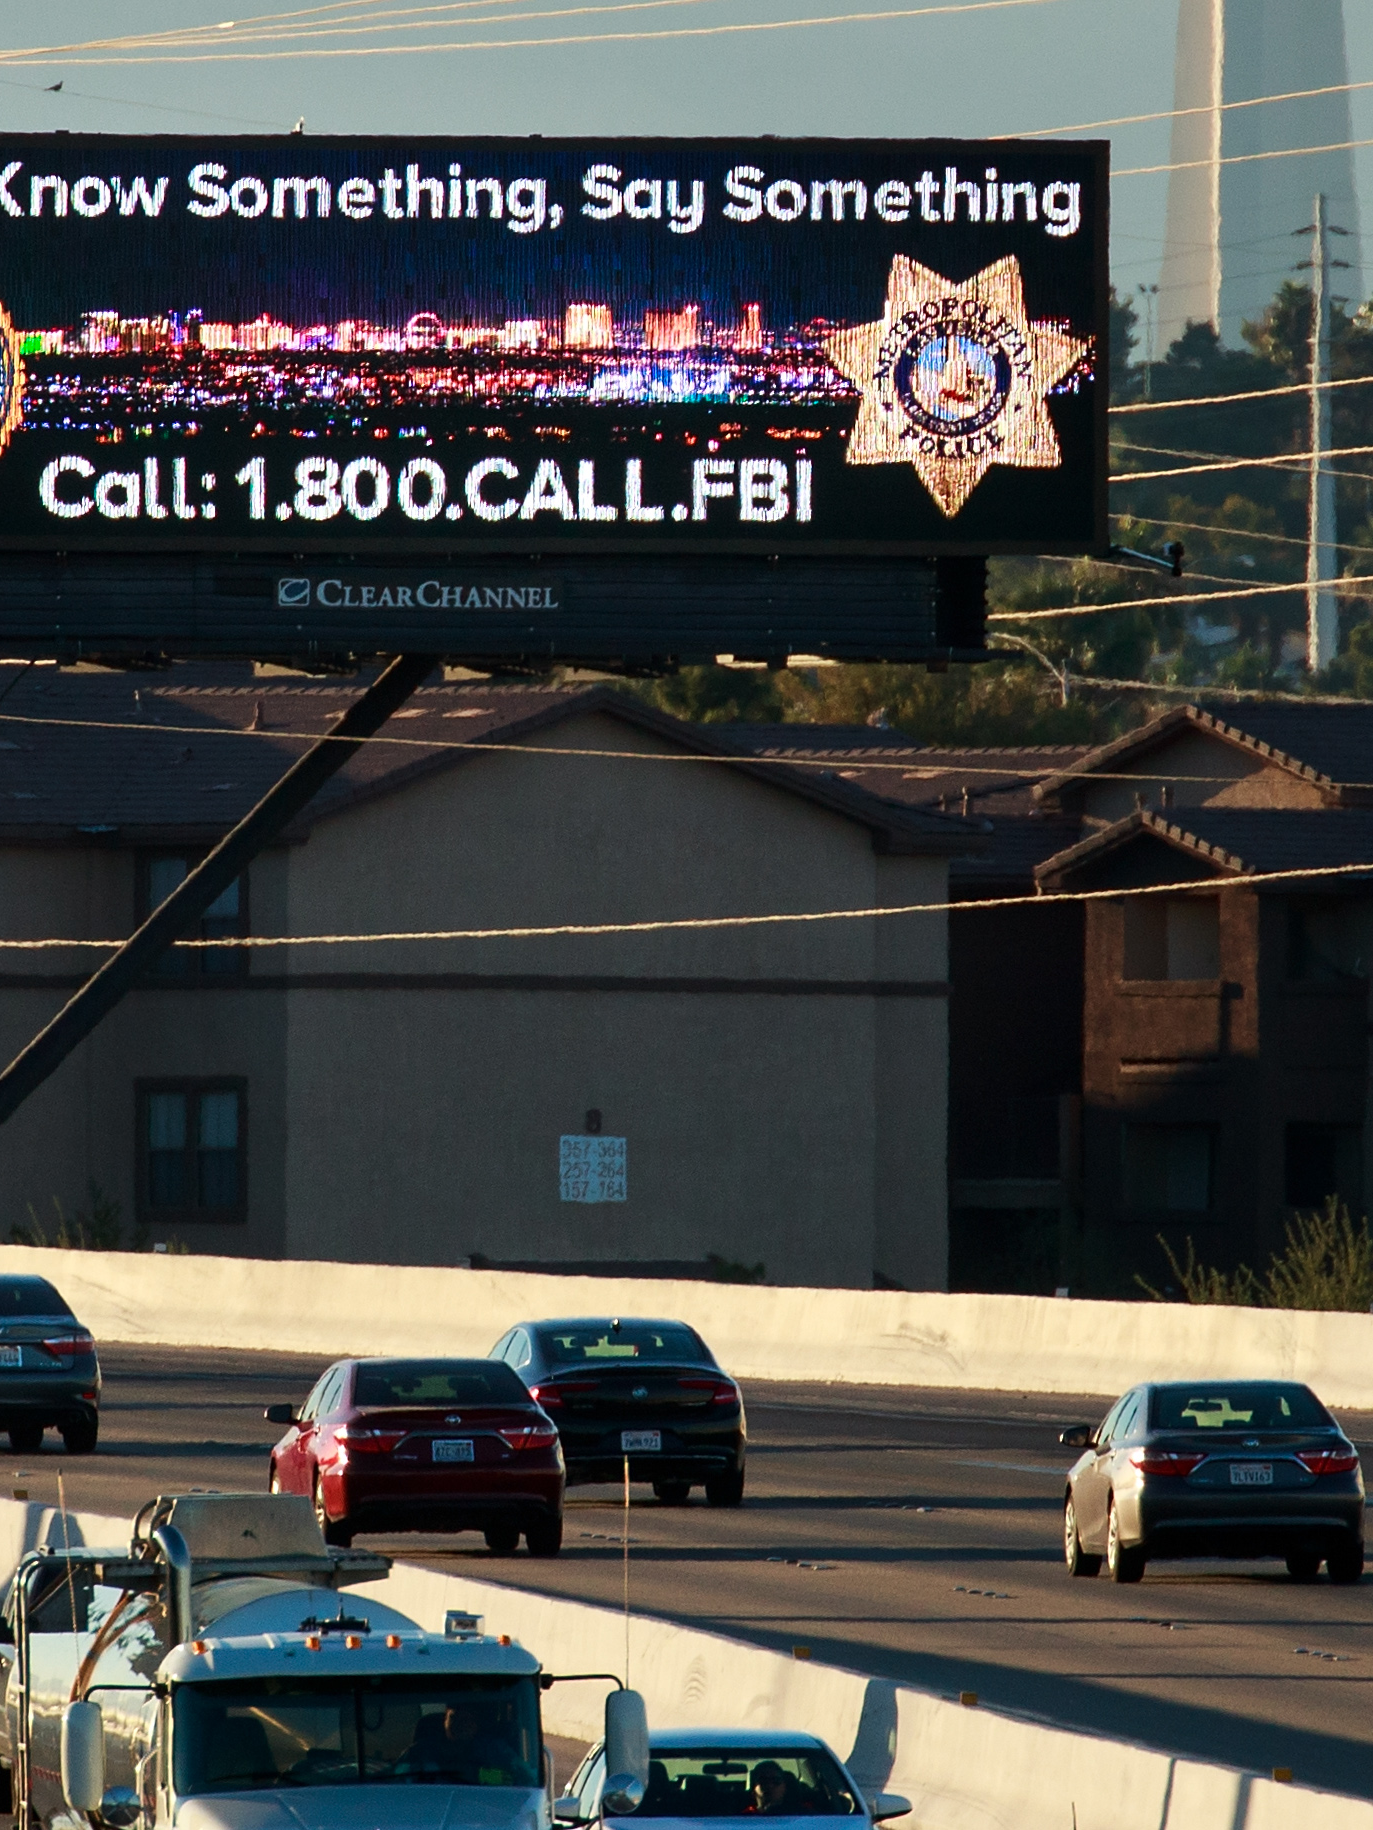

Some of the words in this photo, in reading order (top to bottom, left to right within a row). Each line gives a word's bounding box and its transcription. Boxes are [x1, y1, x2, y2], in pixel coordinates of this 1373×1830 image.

[186, 162, 564, 233] Something,
[582, 164, 705, 233] Say
[722, 165, 1081, 237] Something
[873, 298, 1032, 381] METROPOLITAN
[899, 424, 1004, 459] POLICE
[38, 454, 216, 521] Call:
[234, 456, 814, 524] 1.800.CALL.FBI
